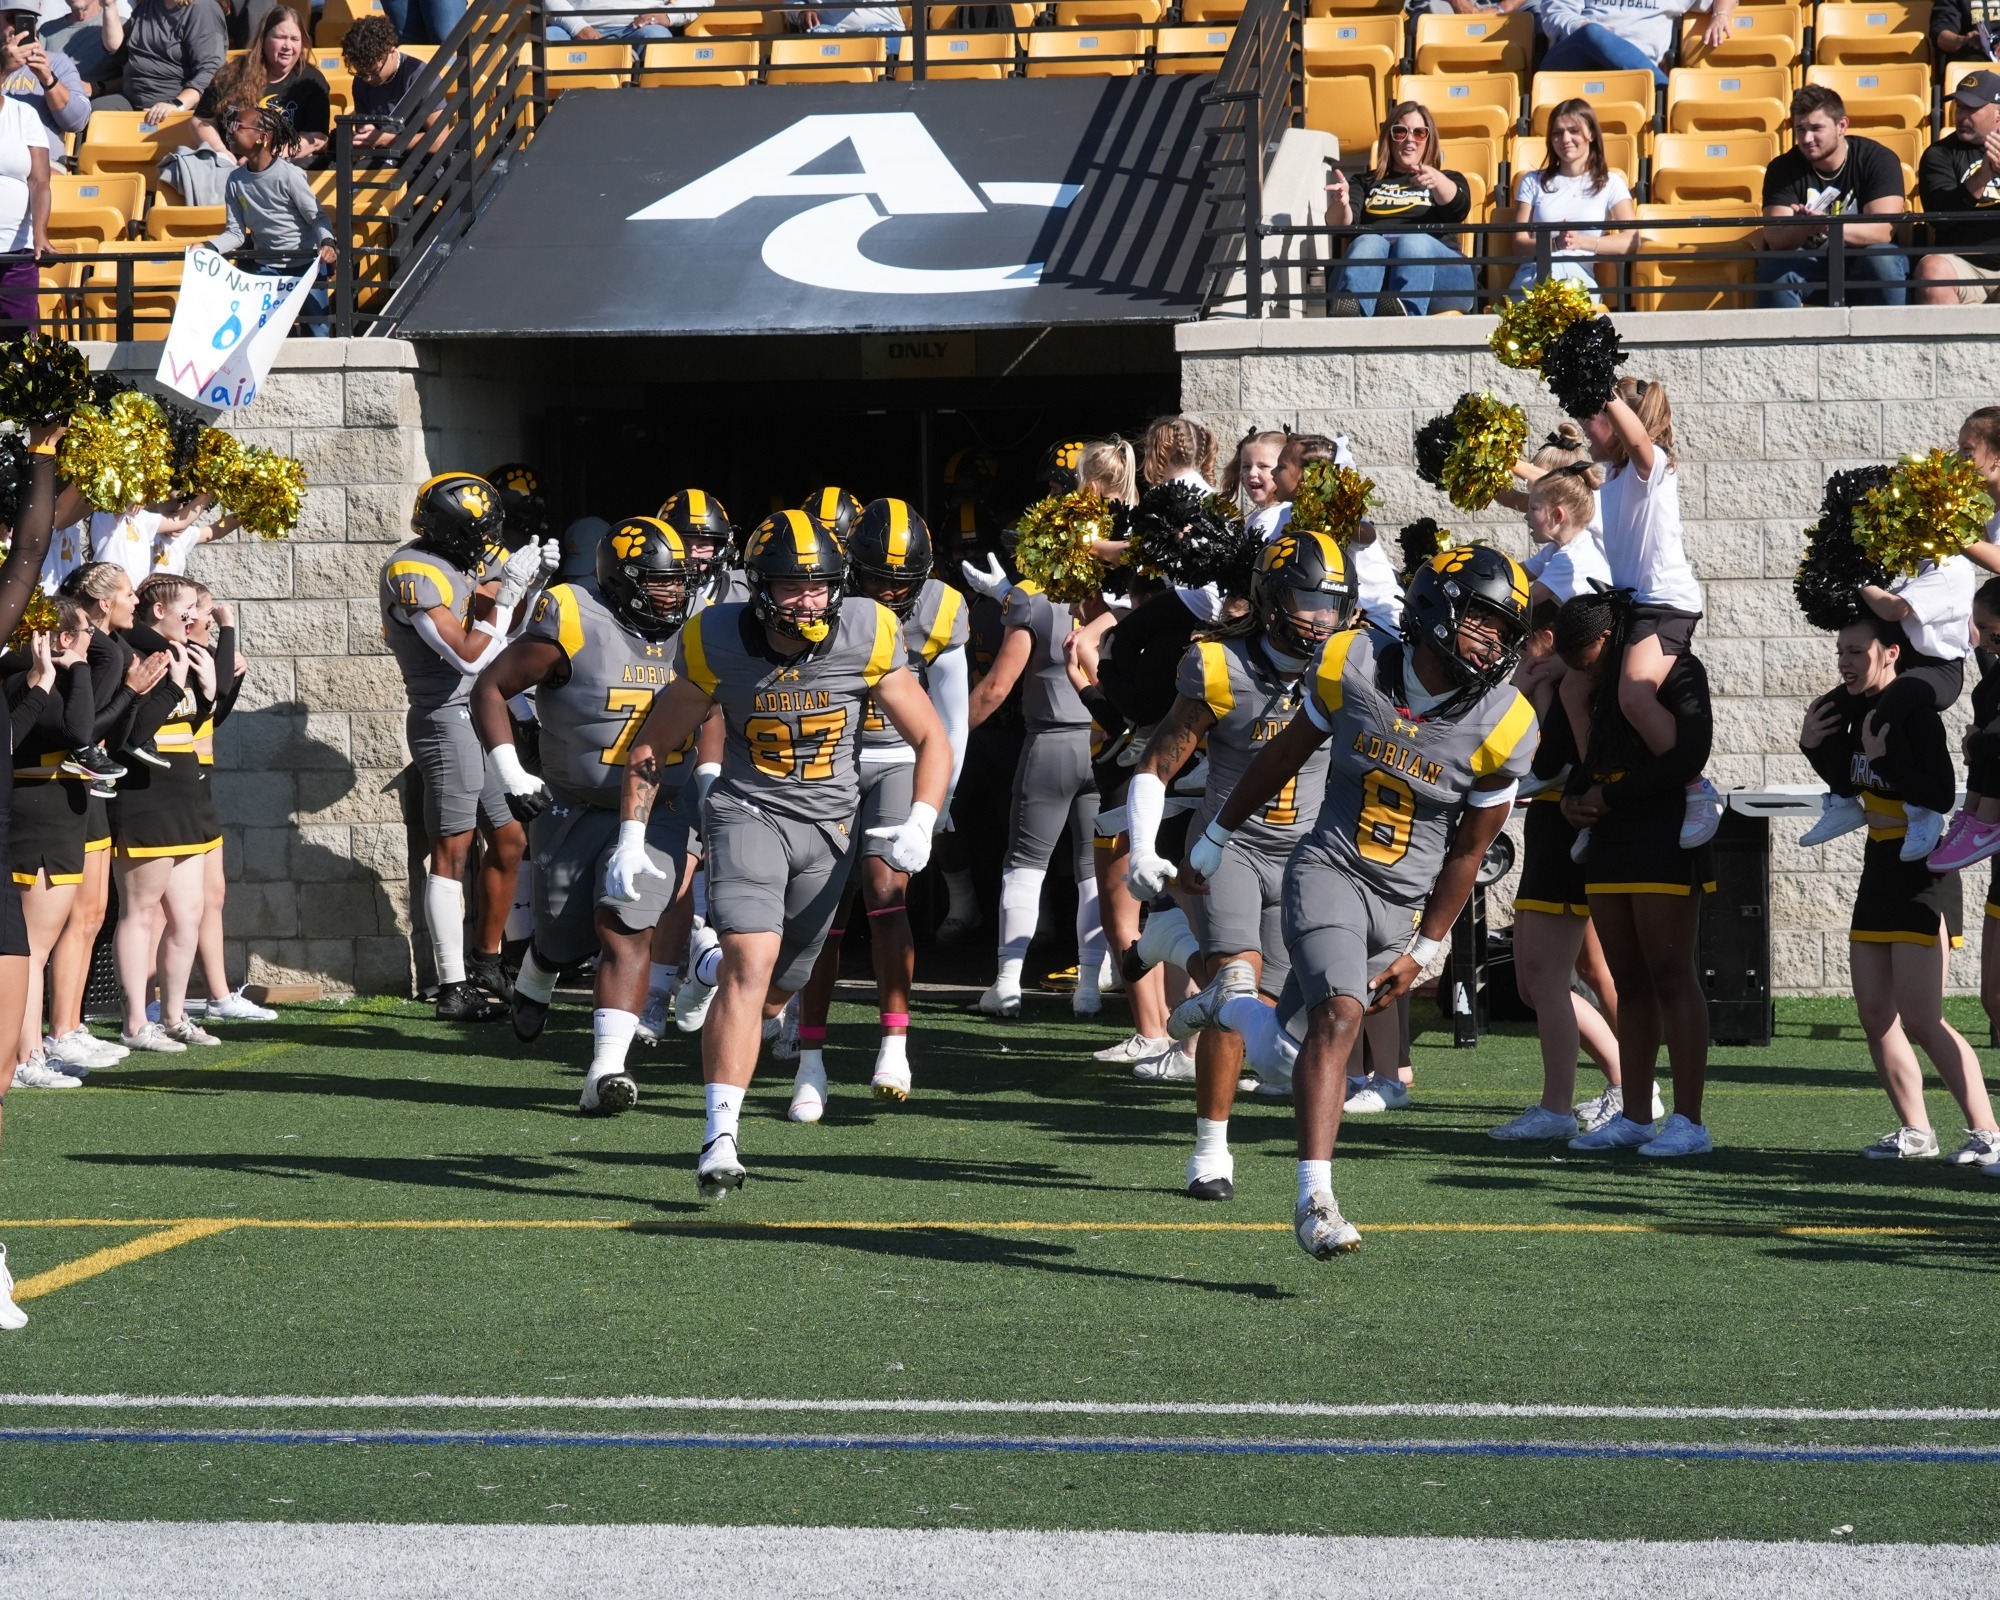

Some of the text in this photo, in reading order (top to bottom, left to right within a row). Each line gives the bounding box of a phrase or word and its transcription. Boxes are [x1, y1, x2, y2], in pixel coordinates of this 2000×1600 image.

[1343, 29, 1349, 38] 8
[571, 53, 582, 62] 14
[698, 50, 710, 58] 13
[824, 46, 836, 55] 12
[1455, 87, 1462, 96] 7
[1712, 147, 1719, 156] 5
[626, 112, 1085, 294] AC
[193, 250, 221, 277] GO
[888, 341, 949, 360] ONLY
[399, 579, 419, 606] 11
[1321, 581, 1349, 593] Riddell
[531, 596, 549, 624] 9
[622, 664, 677, 686] ADRIA
[753, 689, 830, 713] ADRIAN
[744, 706, 848, 782] 87
[1353, 731, 1444, 786] ADRIAN
[1353, 766, 1417, 868] 8
